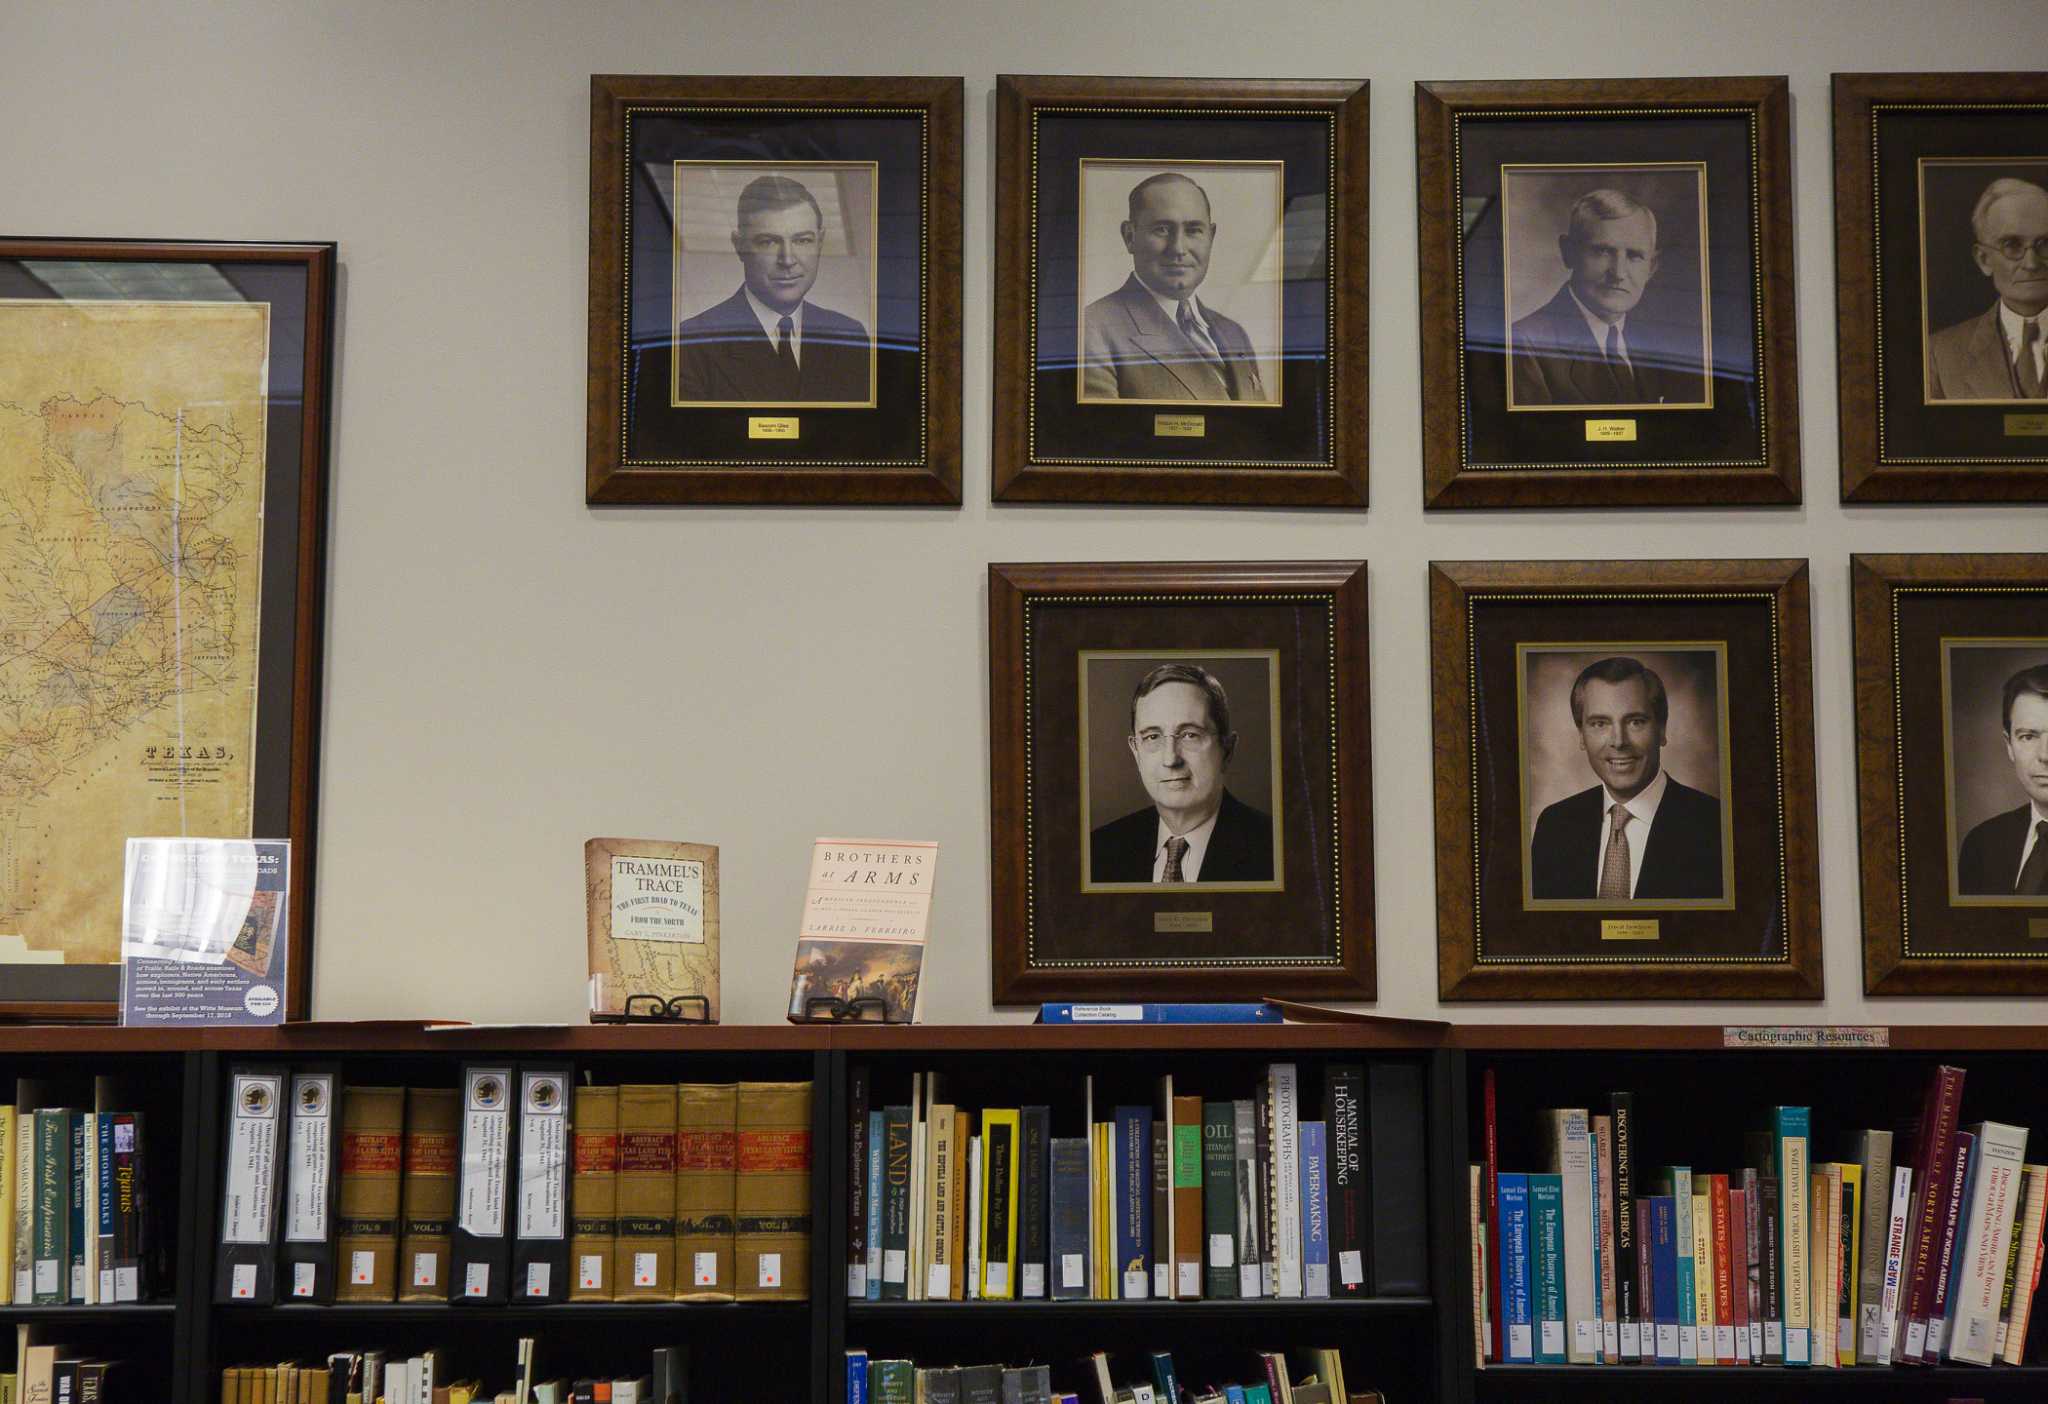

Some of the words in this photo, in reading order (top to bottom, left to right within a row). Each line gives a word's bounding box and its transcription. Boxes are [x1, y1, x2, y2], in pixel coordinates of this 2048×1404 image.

[616, 861, 699, 879] TRAMMEL'S
[824, 851, 922, 864] BROTHERS
[636, 878, 684, 893] TRACE
[844, 870, 920, 885] ARMS
[630, 896, 649, 905] FIRST
[651, 896, 668, 904] ROAD
[680, 902, 698, 916] TEXAS
[631, 915, 649, 924] FROM
[664, 918, 685, 926] NORTH
[1738, 1030, 1813, 1045] Cartographic
[1817, 1030, 1874, 1041] Resources
[854, 1121, 863, 1139] The
[1280, 1075, 1291, 1160] PHOTOGRAPHS
[1347, 1099, 1358, 1150] MANUAL
[74, 1125, 83, 1145] The
[1205, 1124, 1231, 1138] OIL
[1334, 1085, 1348, 1185] HOUSEKEEPING
[1616, 1109, 1628, 1175] DISCOVERING
[74, 1147, 83, 1171] Irish
[888, 1121, 909, 1185] LAND
[938, 1140, 946, 1152] THE
[102, 1147, 110, 1189] CHOSEN
[872, 1149, 880, 1180] Wildlife
[1348, 1153, 1359, 1172] OF
[1791, 1148, 1799, 1198] TAMAULIPAS
[1952, 1147, 1966, 1197] RAILROAD
[872, 1182, 880, 1196] and
[937, 1182, 945, 1197] LAND
[1308, 1156, 1322, 1242] PAPERMAKING
[1619, 1177, 1629, 1197] THE
[1995, 1168, 2012, 1224] DISCOVERING
[102, 1192, 110, 1225] FOLKS
[854, 1190, 862, 1216] Texas
[871, 1198, 879, 1214] Man
[936, 1199, 945, 1211] AND
[1514, 1210, 1524, 1222] The
[1545, 1209, 1556, 1220] The
[1792, 1202, 1800, 1213] DE
[1924, 1183, 1938, 1224] NORTH
[1947, 1198, 1958, 1226] MAPS
[871, 1216, 879, 1225] in
[936, 1214, 945, 1236] CATTLE
[1601, 1209, 1610, 1253] SHEDDING
[1619, 1199, 1630, 1248] AMERICAS
[1717, 1208, 1726, 1241] STATES
[1984, 1206, 1995, 1231] MAPS
[2012, 1221, 2023, 1238] The
[1513, 1224, 1525, 1253] European
[1544, 1222, 1556, 1251] European
[1890, 1216, 1904, 1258] STRANGE
[1946, 1227, 1954, 1239] OF
[1980, 1232, 1988, 1251] AND
[1914, 1226, 1932, 1281] AMERICA
[1941, 1238, 1952, 1266] NORTH
[1988, 1227, 2003, 1270] AMERICAN
[2007, 1241, 2020, 1267] Shape
[1514, 1256, 1525, 1287] Discovery
[1546, 1253, 1557, 1283] Discovery
[1887, 1259, 1898, 1287] MAPS
[1977, 1252, 1988, 1278] VIEWS
[2006, 1269, 2015, 1280] of
[1719, 1269, 1727, 1306] SHAPES
[1936, 1266, 1948, 1304] AMERICA
[1982, 1272, 1996, 1308] HISTORY
[2002, 1283, 2013, 1309] Texas
[1516, 1297, 1526, 1323] America
[1548, 1295, 1558, 1320] America
